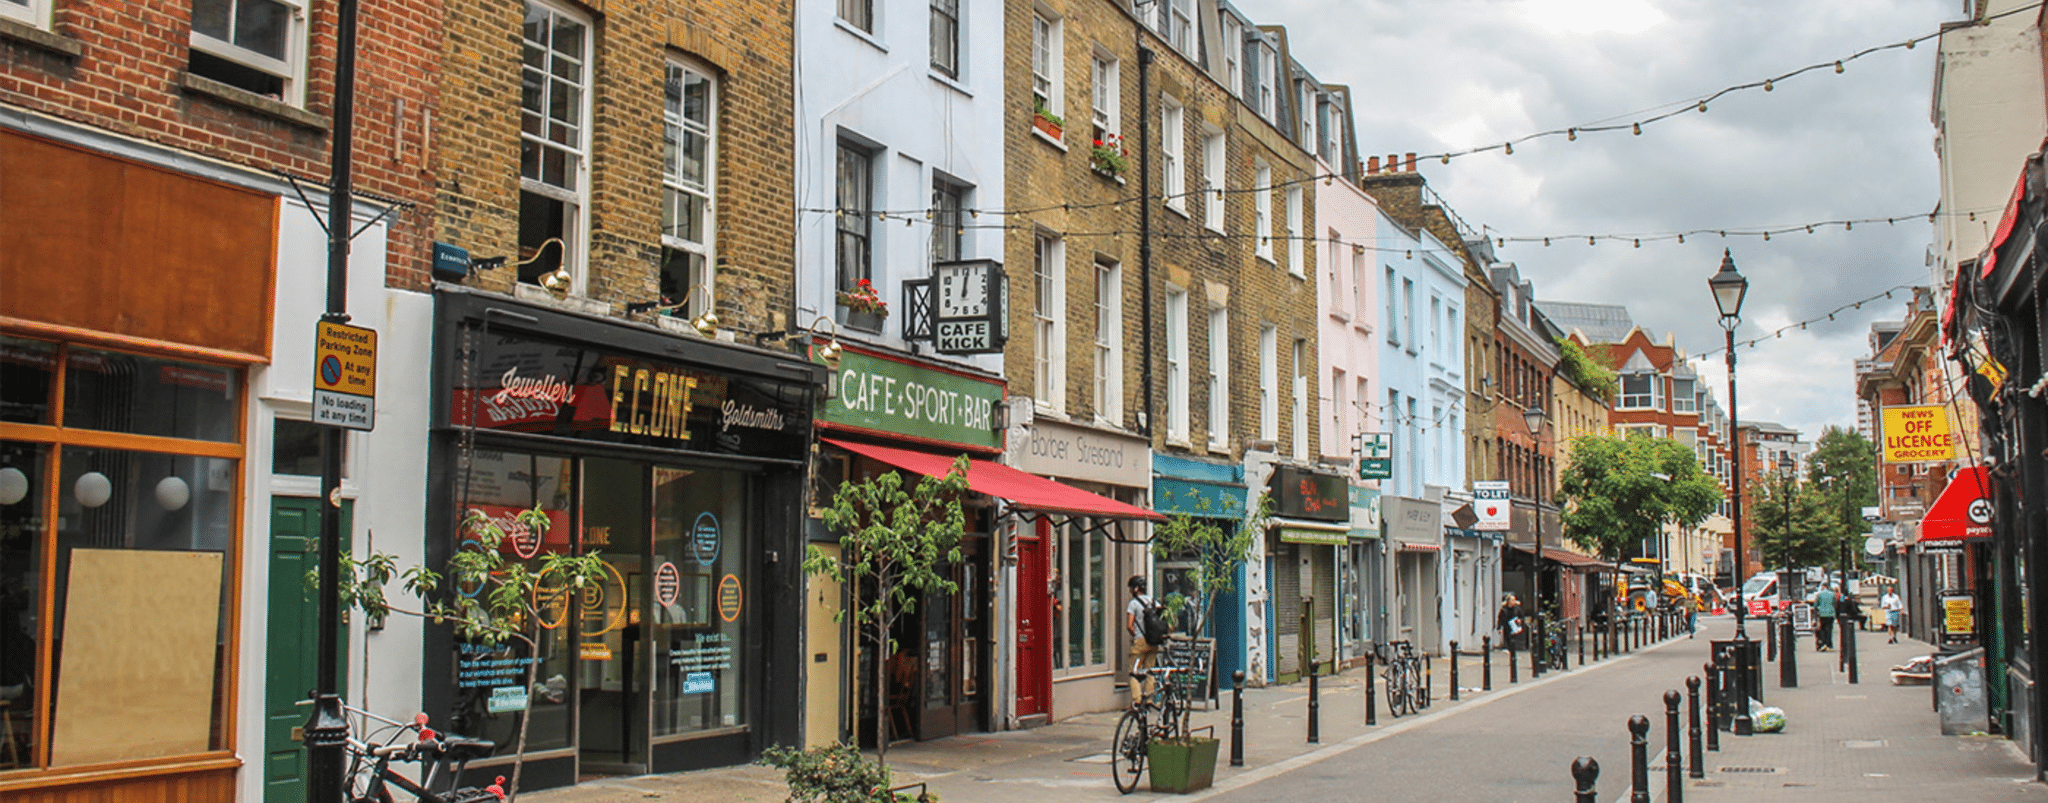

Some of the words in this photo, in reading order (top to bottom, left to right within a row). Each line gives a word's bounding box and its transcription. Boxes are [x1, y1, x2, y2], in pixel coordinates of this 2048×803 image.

[944, 276, 951, 285] 10
[981, 274, 987, 283] 2
[945, 288, 951, 297] 9
[981, 285, 987, 294] 3
[981, 297, 987, 305] 4
[953, 306, 958, 315] 7
[963, 306, 968, 314] 6
[973, 305, 979, 314] 5
[326, 327, 368, 344] Restricted
[940, 324, 985, 336] CAFE
[320, 338, 351, 355] Parking
[353, 344, 373, 358] Zone
[942, 337, 984, 349] KICK
[345, 361, 354, 372] At
[356, 365, 370, 376] any
[348, 374, 366, 386] time
[496, 366, 575, 404] Jewellers
[322, 396, 335, 407] No
[336, 398, 366, 413] loading
[609, 364, 698, 440] E.C.ONE
[841, 368, 895, 415] CAFE
[904, 381, 959, 427] SPORT
[964, 396, 991, 431] BAR
[320, 410, 330, 419] at
[332, 411, 346, 422] any
[349, 412, 366, 424] time
[722, 399, 785, 432] Goldsmiths
[1902, 410, 1934, 419] NEWS
[1905, 420, 1933, 433] OFF
[1888, 434, 1951, 449] LICENCE
[1031, 429, 1070, 461] Barber
[1076, 436, 1124, 469] Streisand
[1894, 449, 1946, 458] GROCERY
[1475, 490, 1490, 499] TO
[1491, 490, 1508, 499] LET
